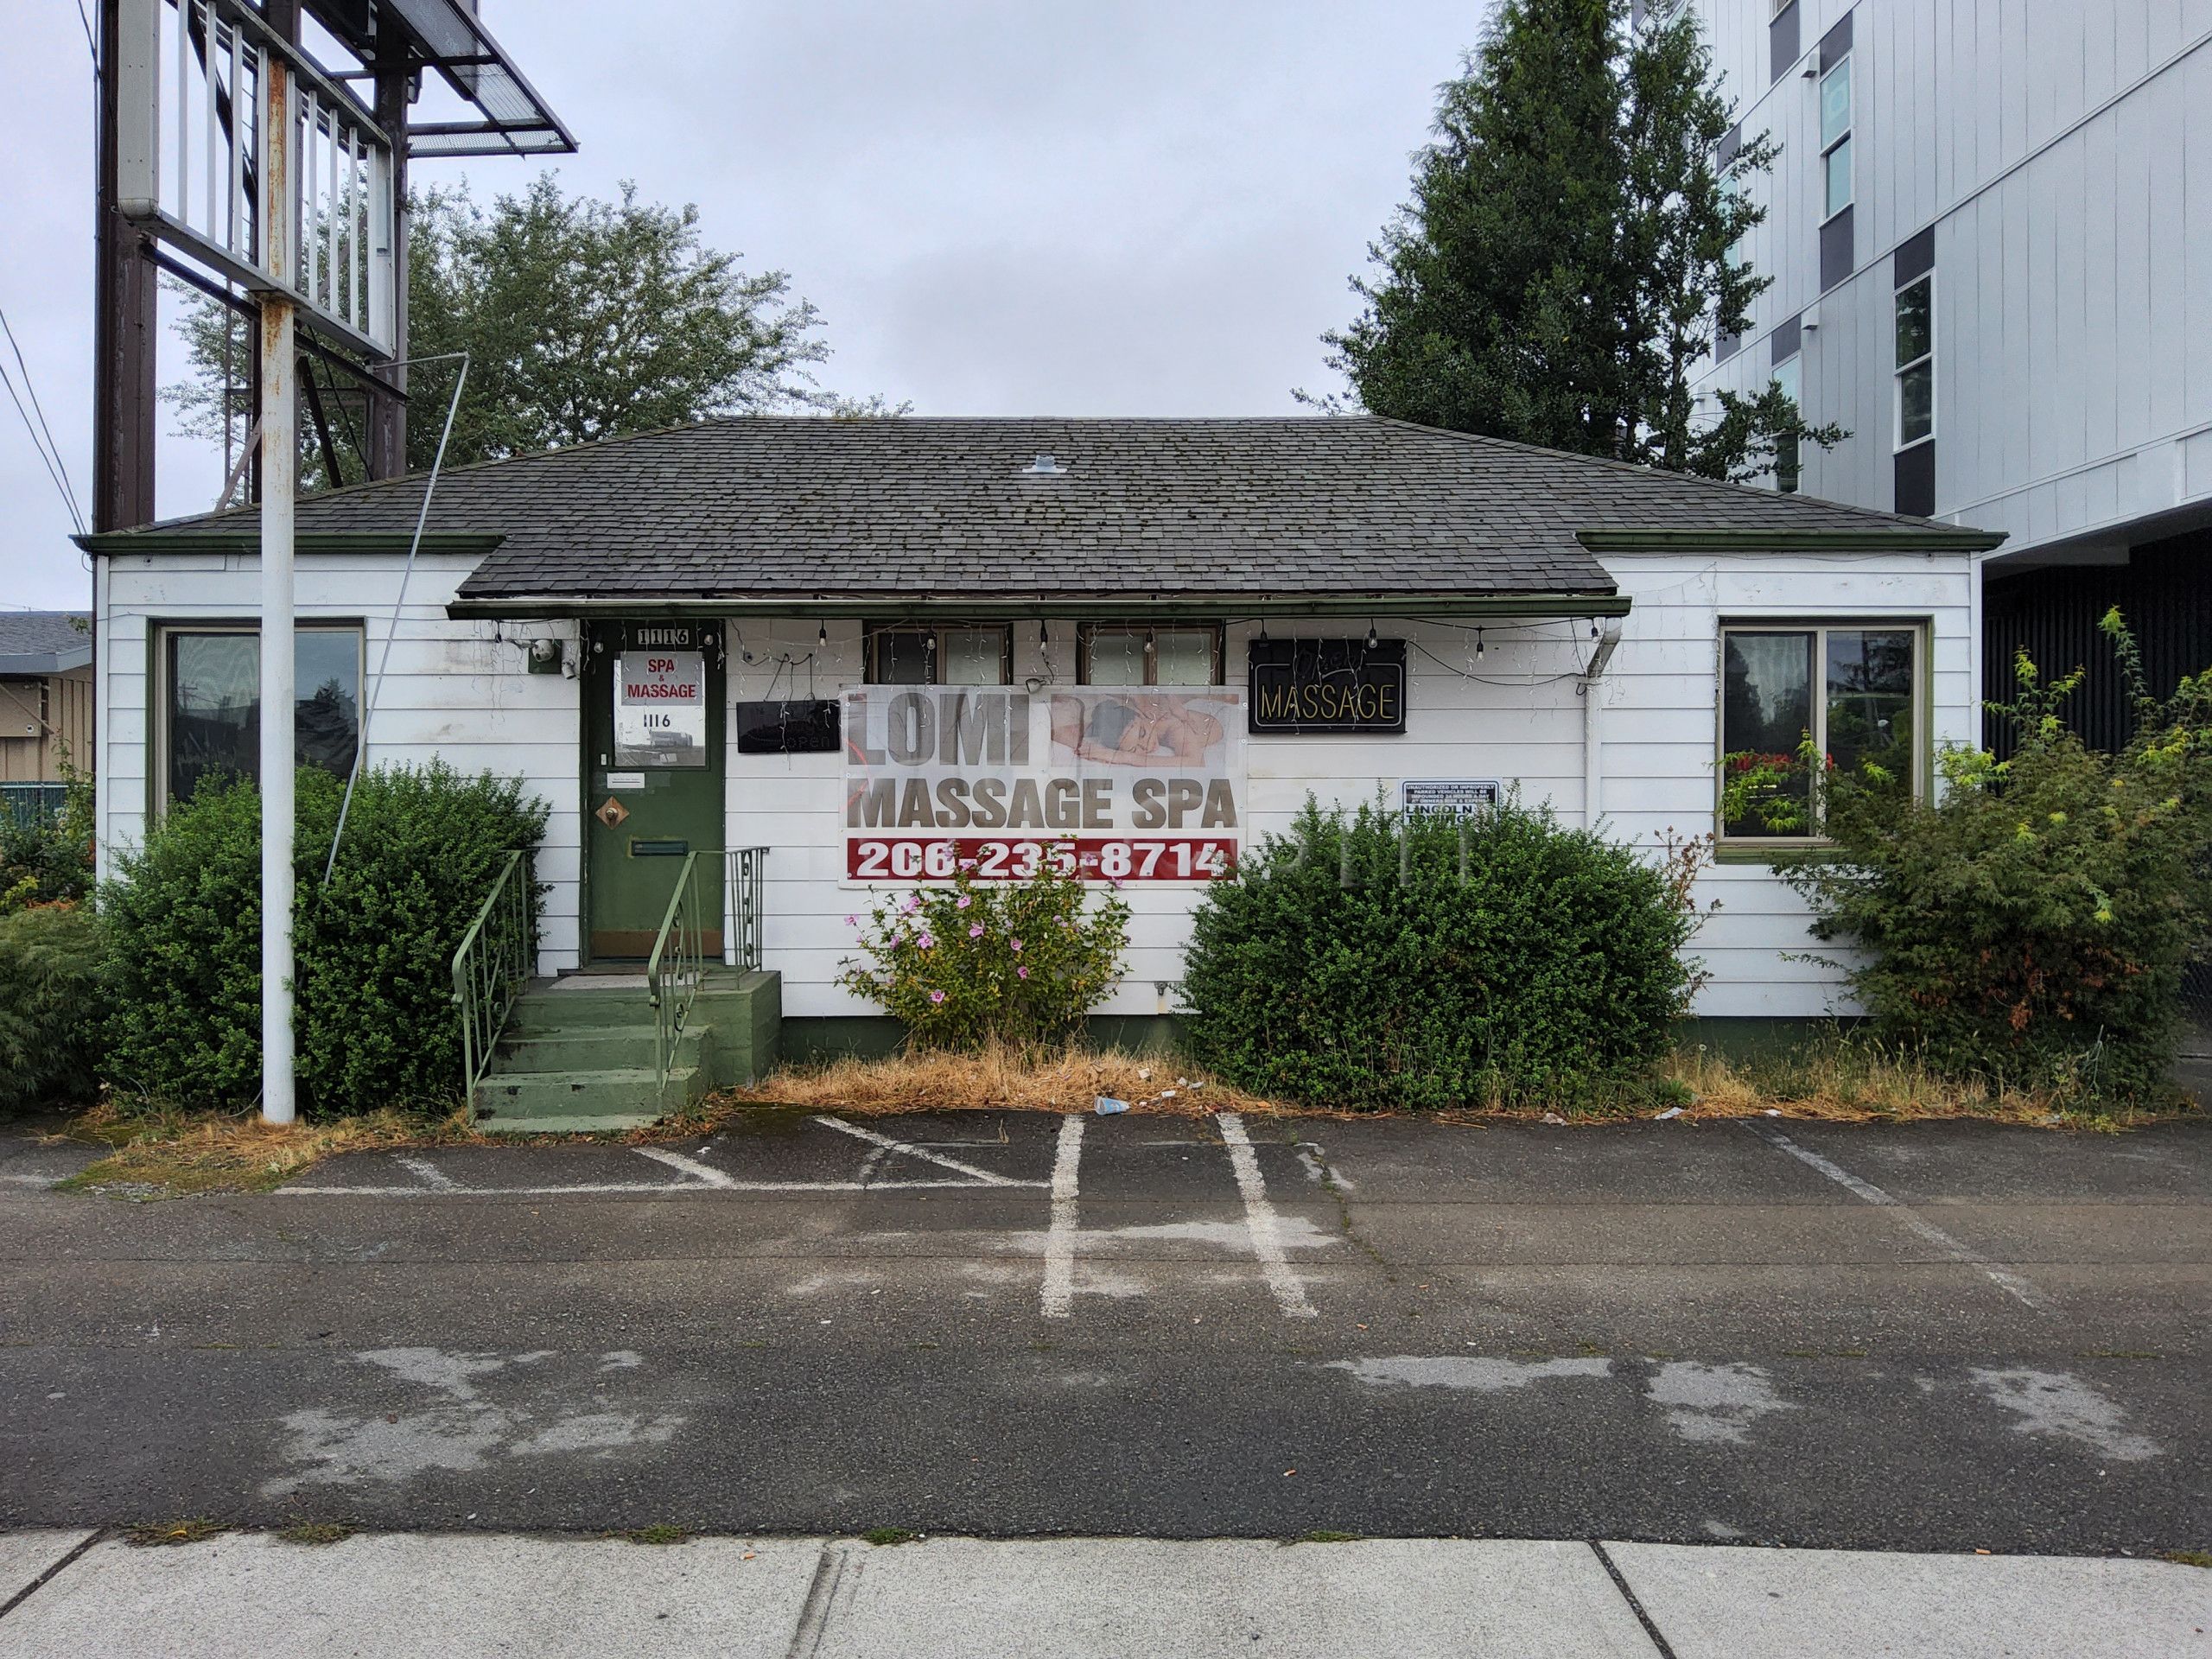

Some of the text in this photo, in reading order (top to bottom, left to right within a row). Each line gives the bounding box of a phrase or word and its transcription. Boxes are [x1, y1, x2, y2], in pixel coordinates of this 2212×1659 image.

[639, 630, 689, 644] 1116
[648, 658, 675, 673] SPA
[627, 684, 696, 698] MASSAGE
[1262, 684, 1395, 719] MASSAGE
[644, 714, 671, 728] 1116
[848, 693, 1030, 766] LOMI
[847, 778, 1239, 829] MASSAGE SPA
[1406, 804, 1472, 814] LINCOLN
[857, 842, 1226, 878] 206-235-8714
